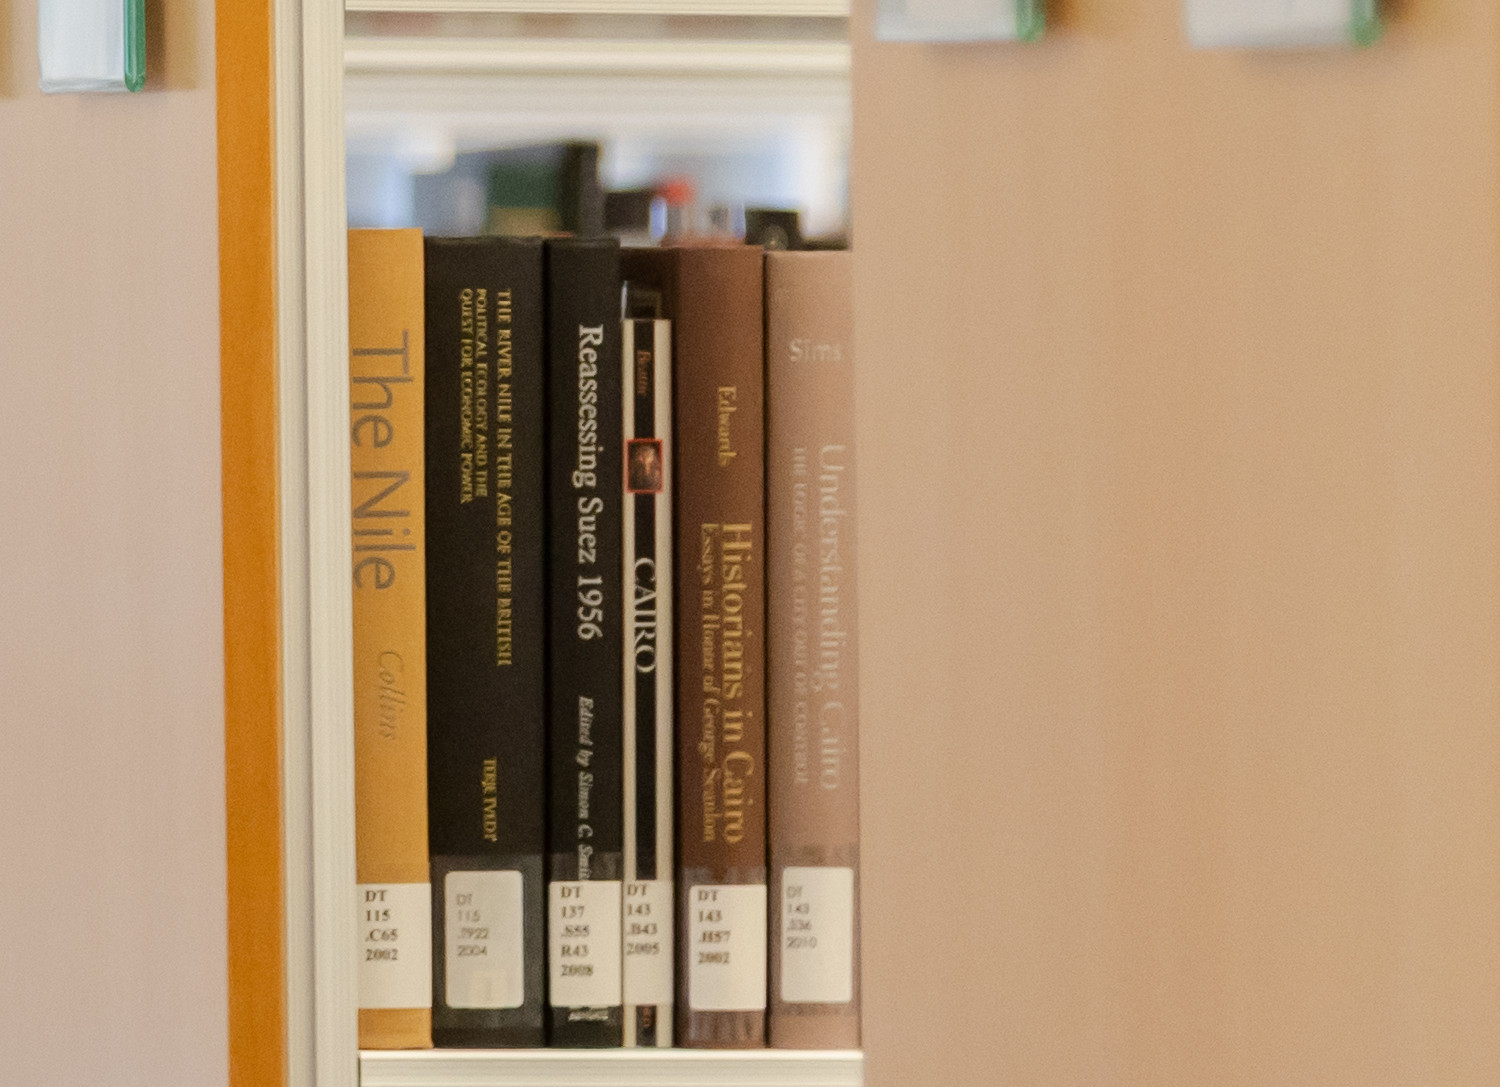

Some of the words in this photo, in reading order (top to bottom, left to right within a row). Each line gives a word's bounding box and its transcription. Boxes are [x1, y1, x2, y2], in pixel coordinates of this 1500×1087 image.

[497, 288, 513, 323] THE
[497, 329, 513, 380] RIVER
[351, 330, 415, 449] The
[497, 384, 513, 424] NILE
[571, 324, 604, 489] Reassessing
[497, 428, 513, 449] IN
[717, 386, 738, 468] Edwards
[497, 453, 513, 489] THE
[497, 492, 513, 526] AGE
[353, 470, 417, 590] Nile
[495, 530, 513, 554] OF
[577, 496, 604, 565] Suez
[697, 522, 720, 586] Essays
[497, 559, 513, 593] THE
[577, 575, 604, 641] 1956
[634, 557, 657, 673] CAIRO
[721, 522, 754, 700] Historians
[497, 598, 513, 667] BRITISH
[378, 650, 407, 741] Collins
[577, 695, 594, 746] Edited
[721, 710, 754, 743] in
[575, 749, 593, 768] by
[577, 770, 594, 819] Simon
[721, 750, 756, 845] Cairo
[365, 890, 387, 903] DT
[561, 886, 582, 899] DT
[627, 884, 647, 896] DT
[698, 889, 719, 902] DT
[366, 909, 390, 922] 115
[561, 905, 584, 918] 137
[627, 903, 650, 916] 143
[698, 909, 722, 922] 143
[365, 948, 398, 962] 2002
